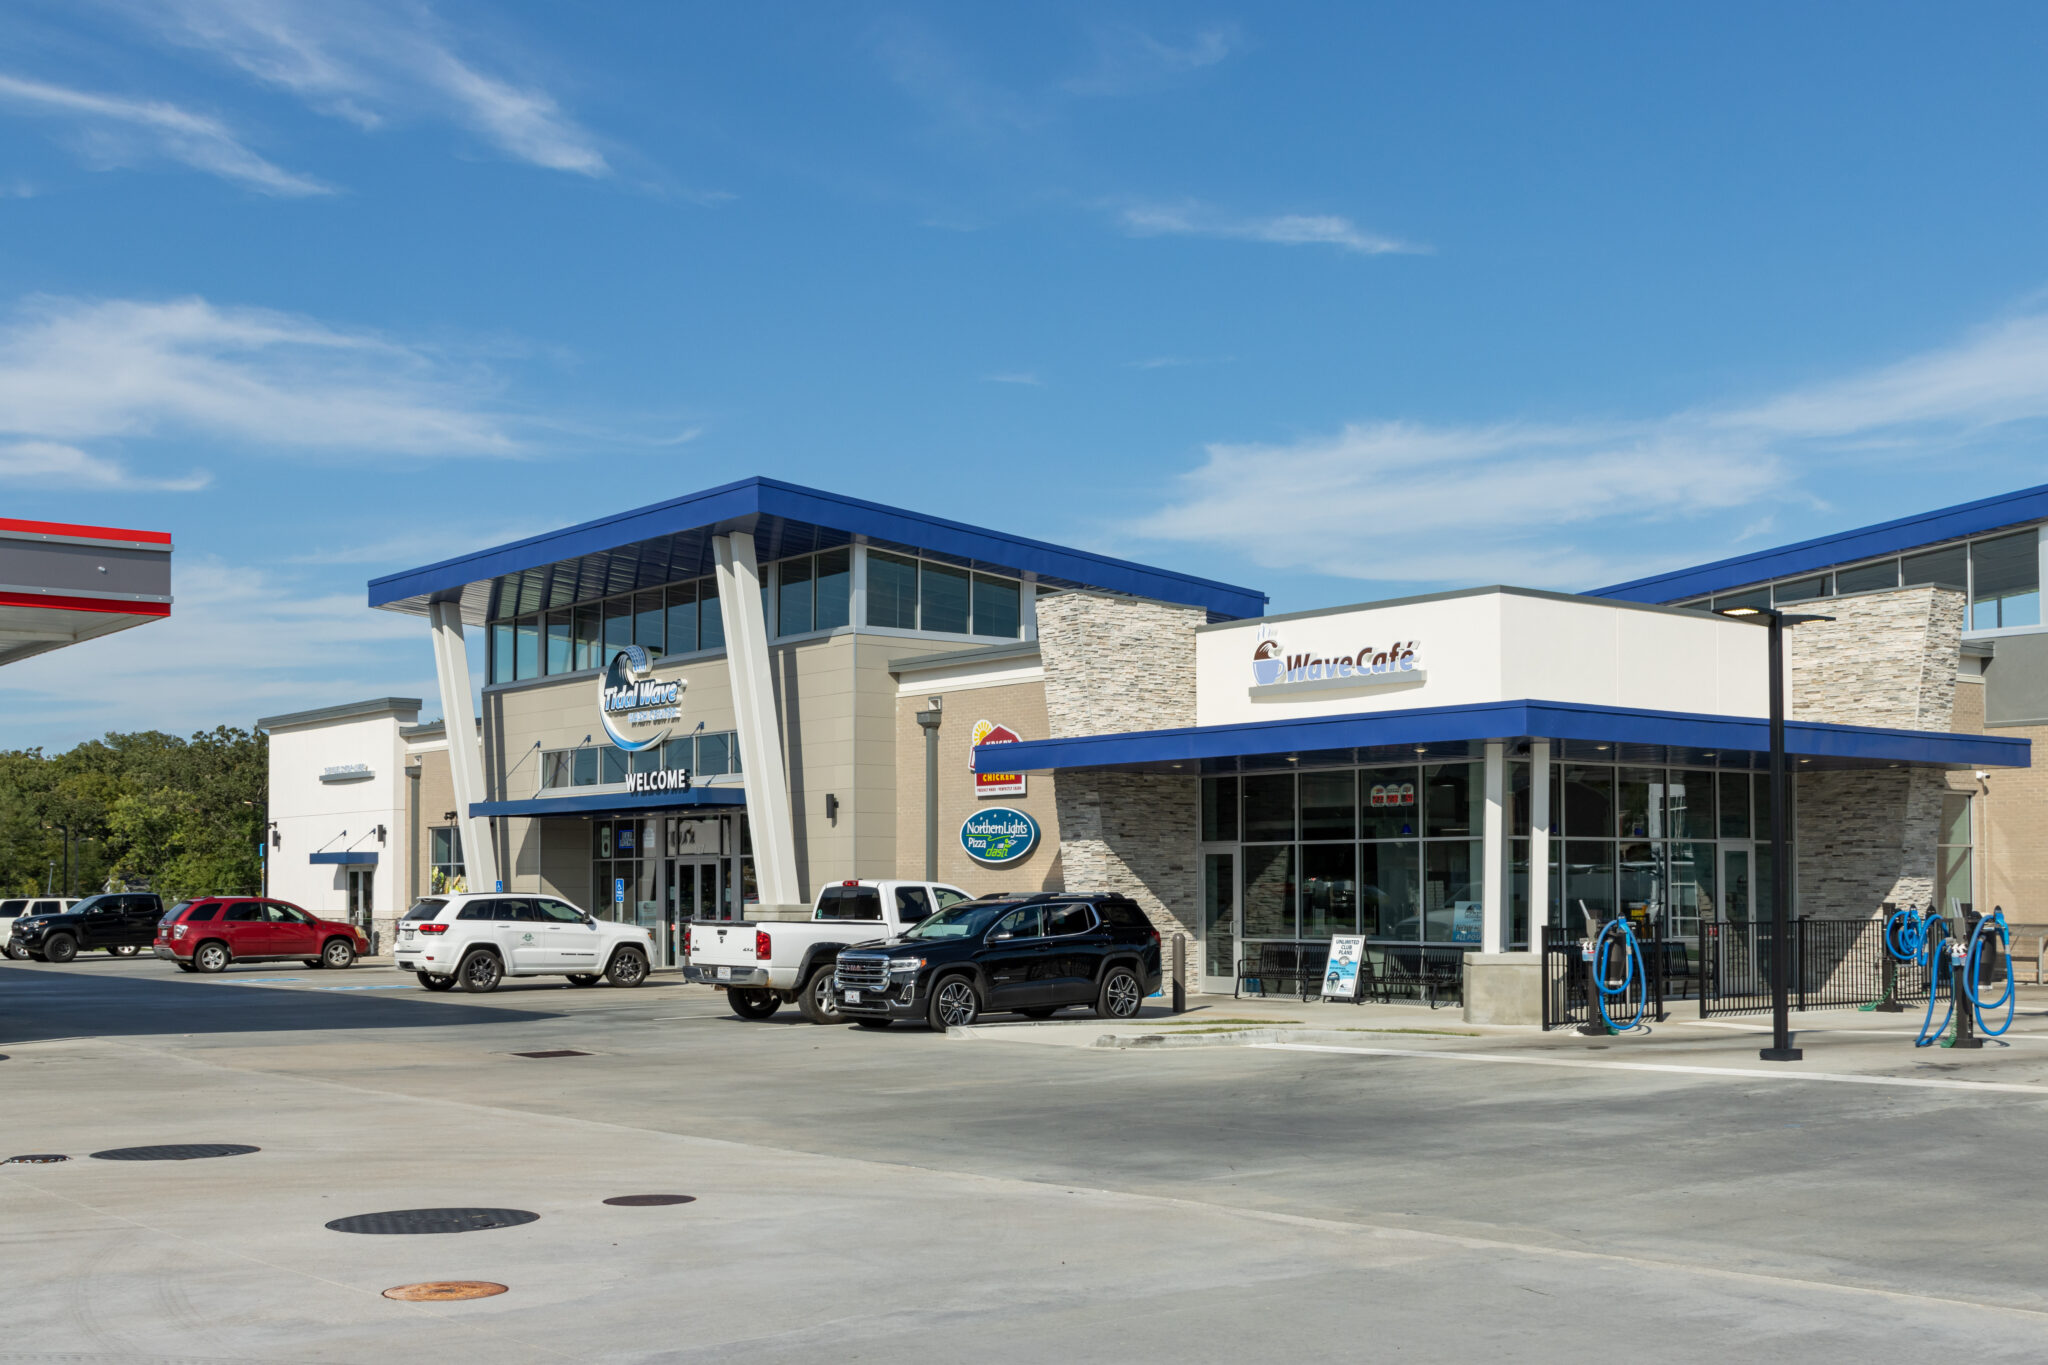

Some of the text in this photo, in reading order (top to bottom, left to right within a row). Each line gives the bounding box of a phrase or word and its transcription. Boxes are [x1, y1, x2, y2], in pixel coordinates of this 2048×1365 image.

[1287, 641, 1414, 682] Wave Café
[604, 680, 678, 711] Tidal Wave
[625, 768, 686, 792] WELCOME
[982, 774, 1016, 782] CHICKEN
[968, 837, 987, 849] Pizza
[985, 843, 1009, 858] dash
